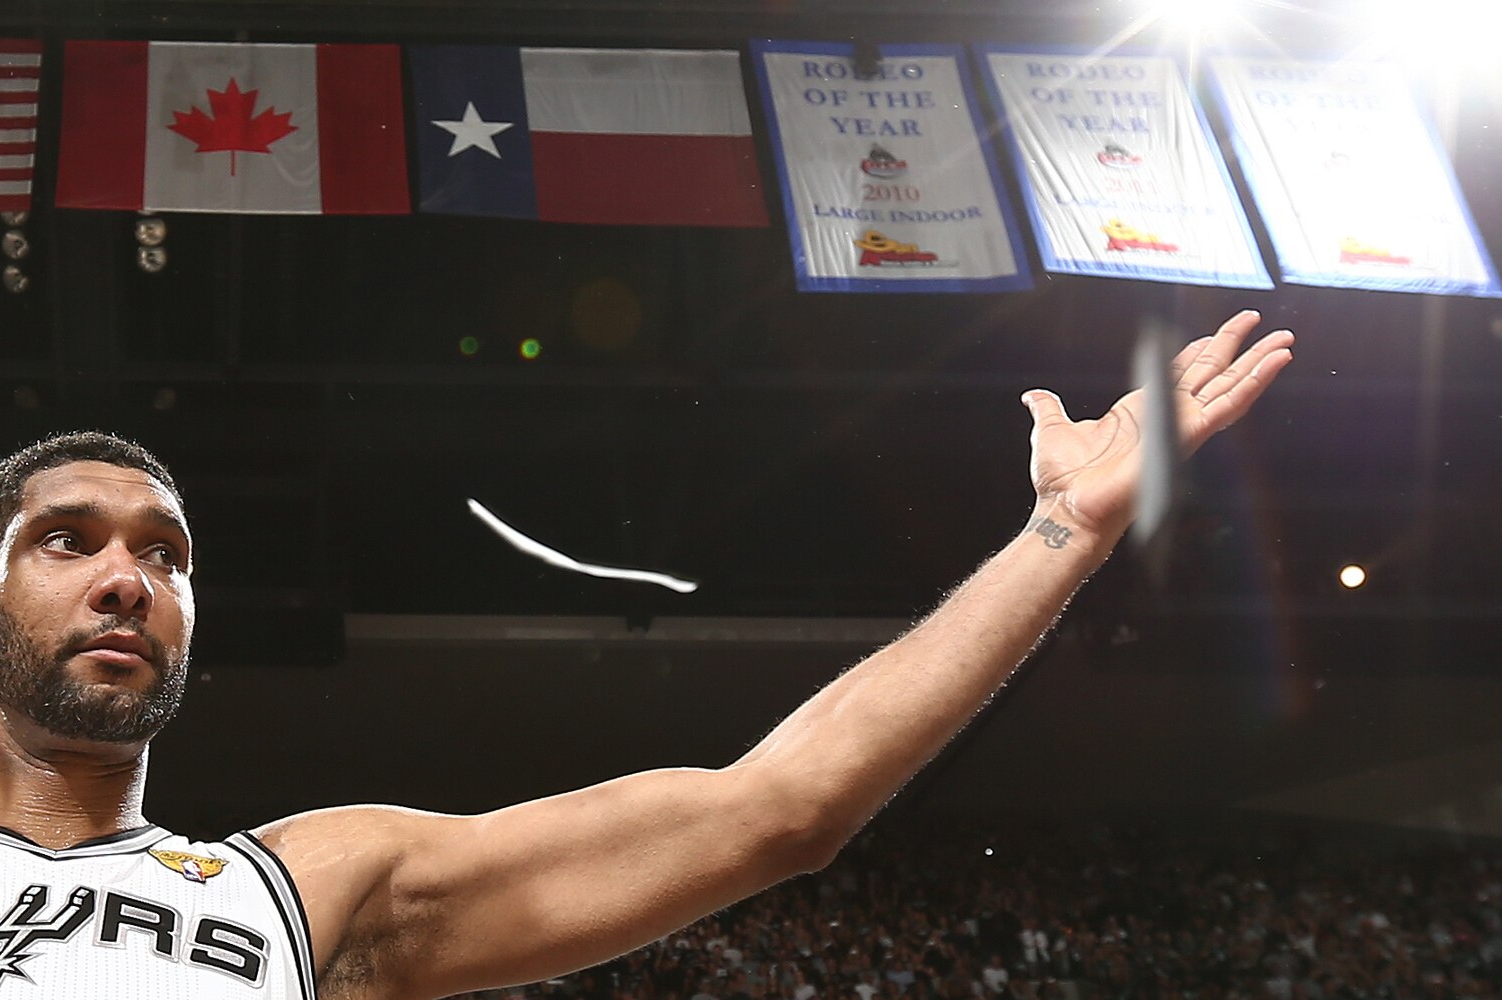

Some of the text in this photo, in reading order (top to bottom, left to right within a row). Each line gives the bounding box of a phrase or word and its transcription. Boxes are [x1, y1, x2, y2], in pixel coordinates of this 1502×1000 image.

[802, 61, 925, 80] ROEO
[803, 88, 936, 109] OF THE
[1031, 87, 1162, 106] OF THE
[829, 116, 923, 137] YEAR
[1059, 114, 1150, 132] YEAR
[863, 184, 921, 201] 2010
[814, 203, 984, 223] LARGE INDOOR
